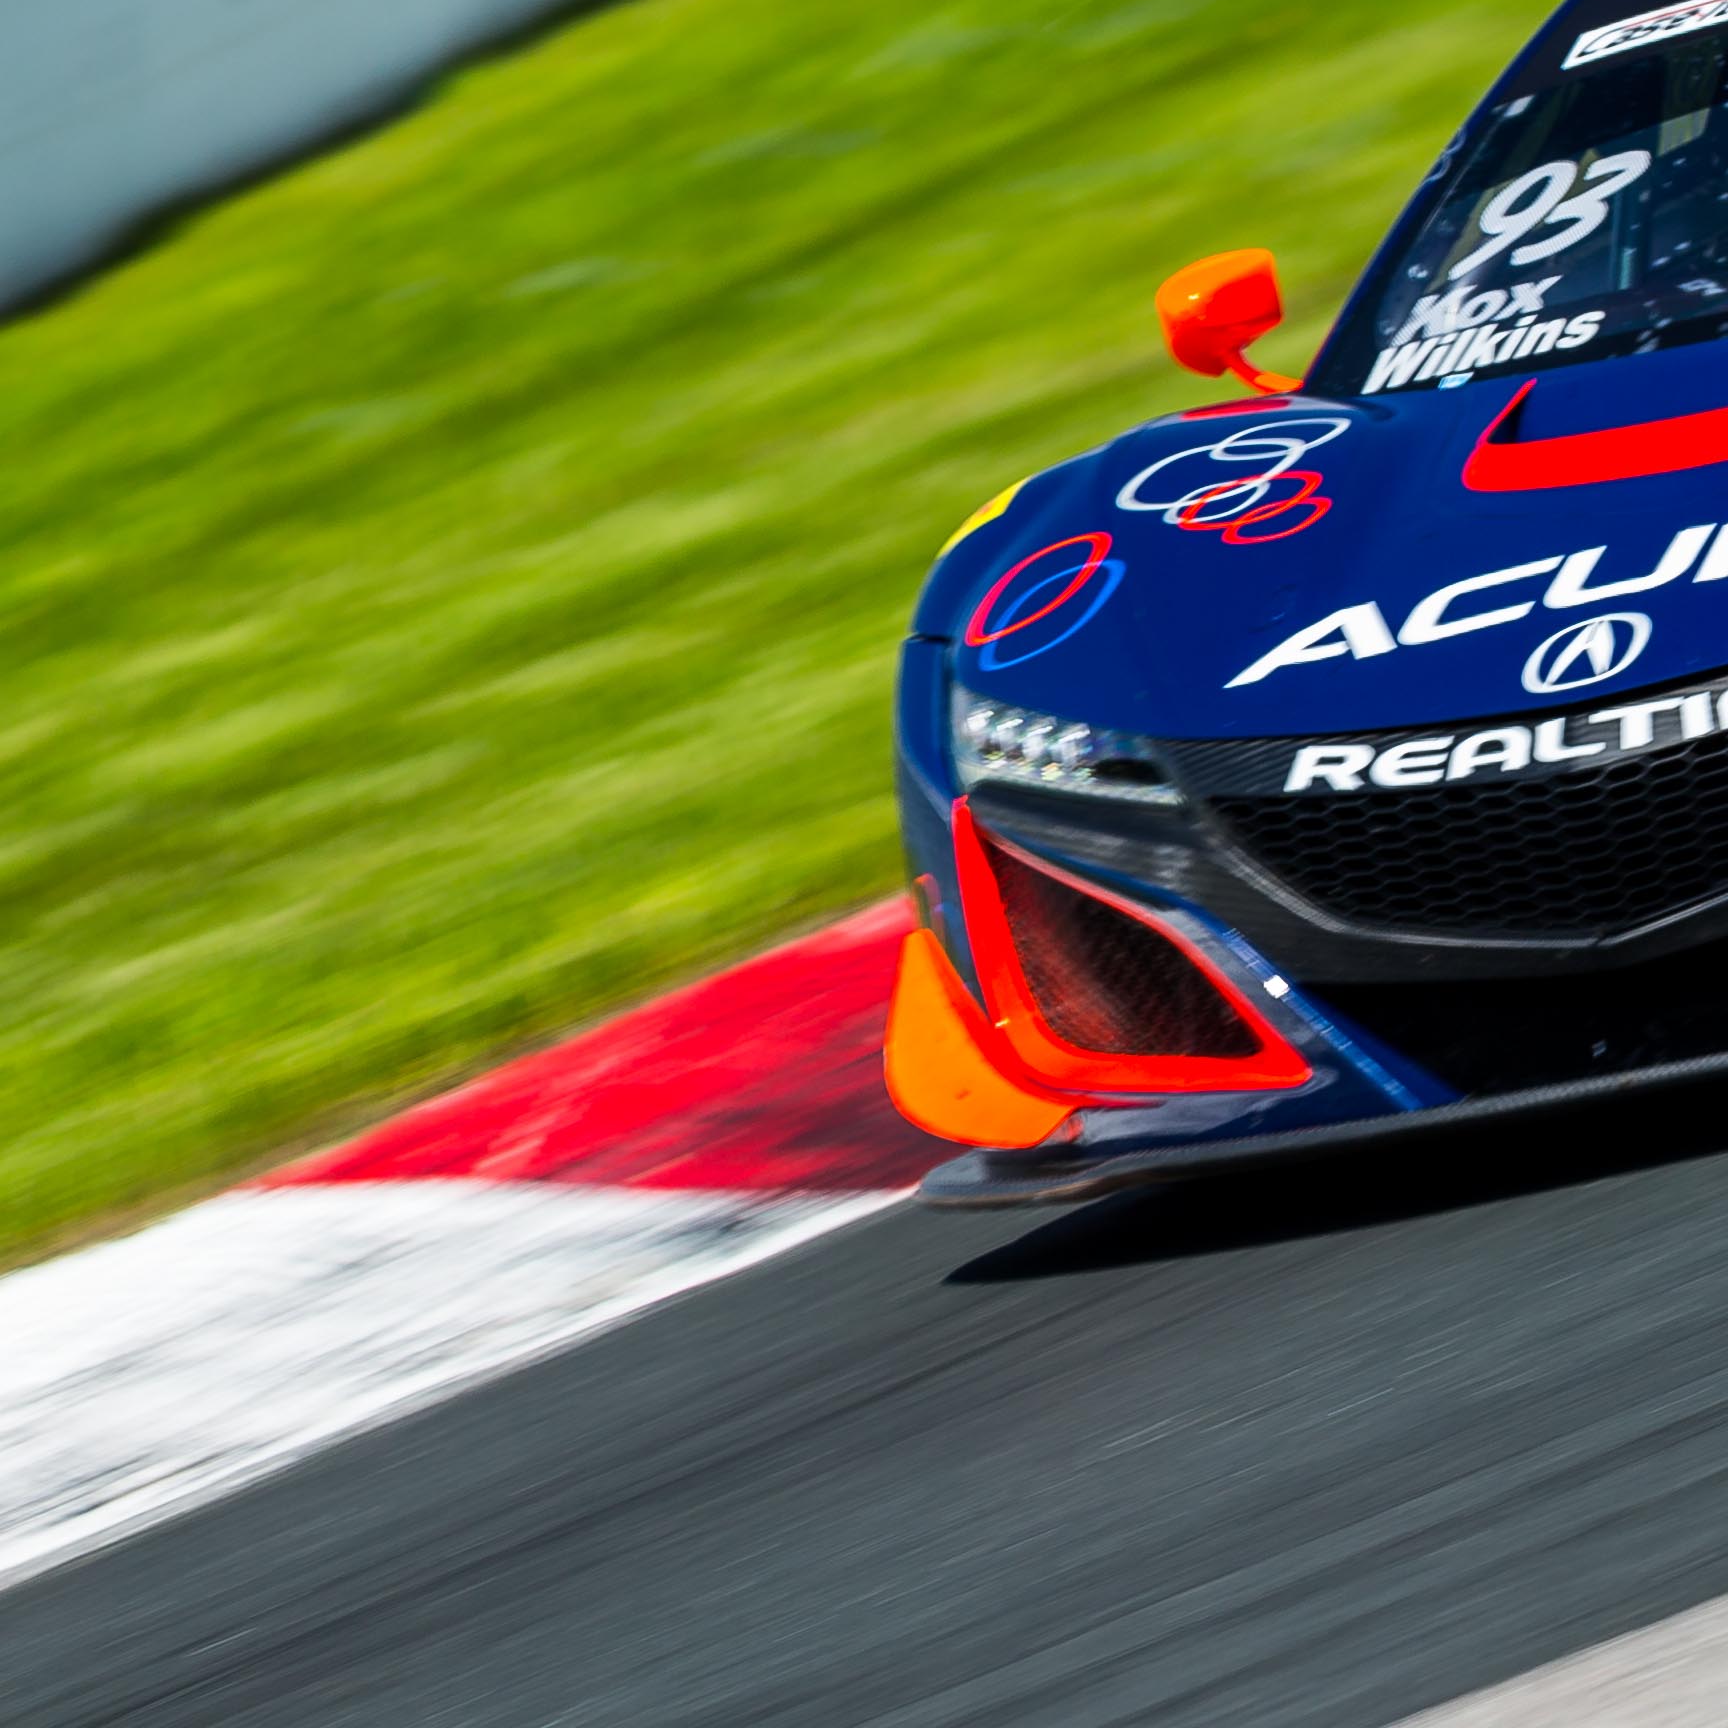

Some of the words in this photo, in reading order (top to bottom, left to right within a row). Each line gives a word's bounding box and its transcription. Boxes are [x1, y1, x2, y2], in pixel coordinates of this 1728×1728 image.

[1448, 150, 1652, 280] 93
[1360, 310, 1606, 395] Wilkins
[1390, 275, 1564, 349] Kox
